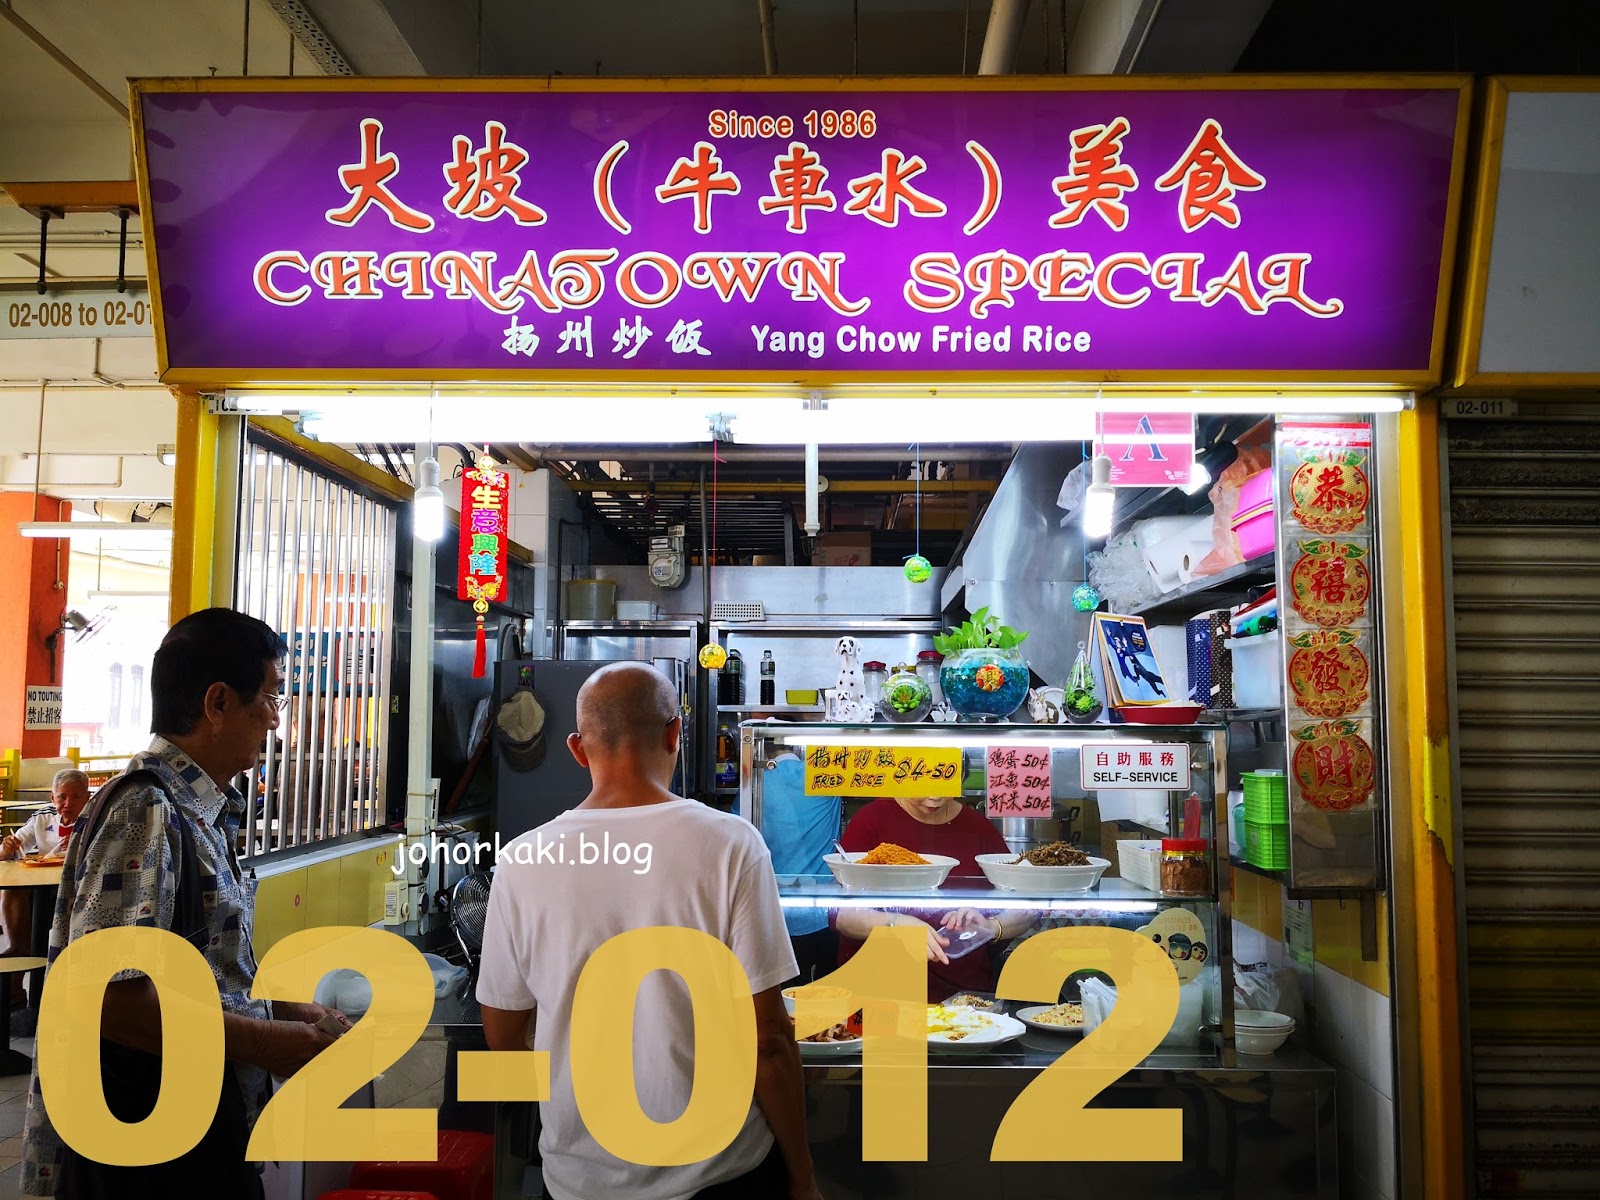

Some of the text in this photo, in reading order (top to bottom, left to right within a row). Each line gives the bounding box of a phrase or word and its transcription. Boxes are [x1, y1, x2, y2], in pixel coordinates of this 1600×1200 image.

[709, 110, 877, 139] Since 1986
[251, 248, 1345, 320] CHINATOWN SPECIAL
[8, 302, 73, 327] 02-008
[78, 303, 98, 326] to
[502, 315, 712, 359] 扬州炒饭
[751, 325, 1091, 359] Yang Chow Fried Rice
[1456, 401, 1503, 415] 02-011
[468, 486, 502, 577] 生意興隆
[27, 691, 62, 701] NO TOUTING
[1096, 751, 1175, 766] 自助服務
[812, 773, 885, 790] FRIED RICE
[1093, 772, 1178, 782] SELF-SERVICE
